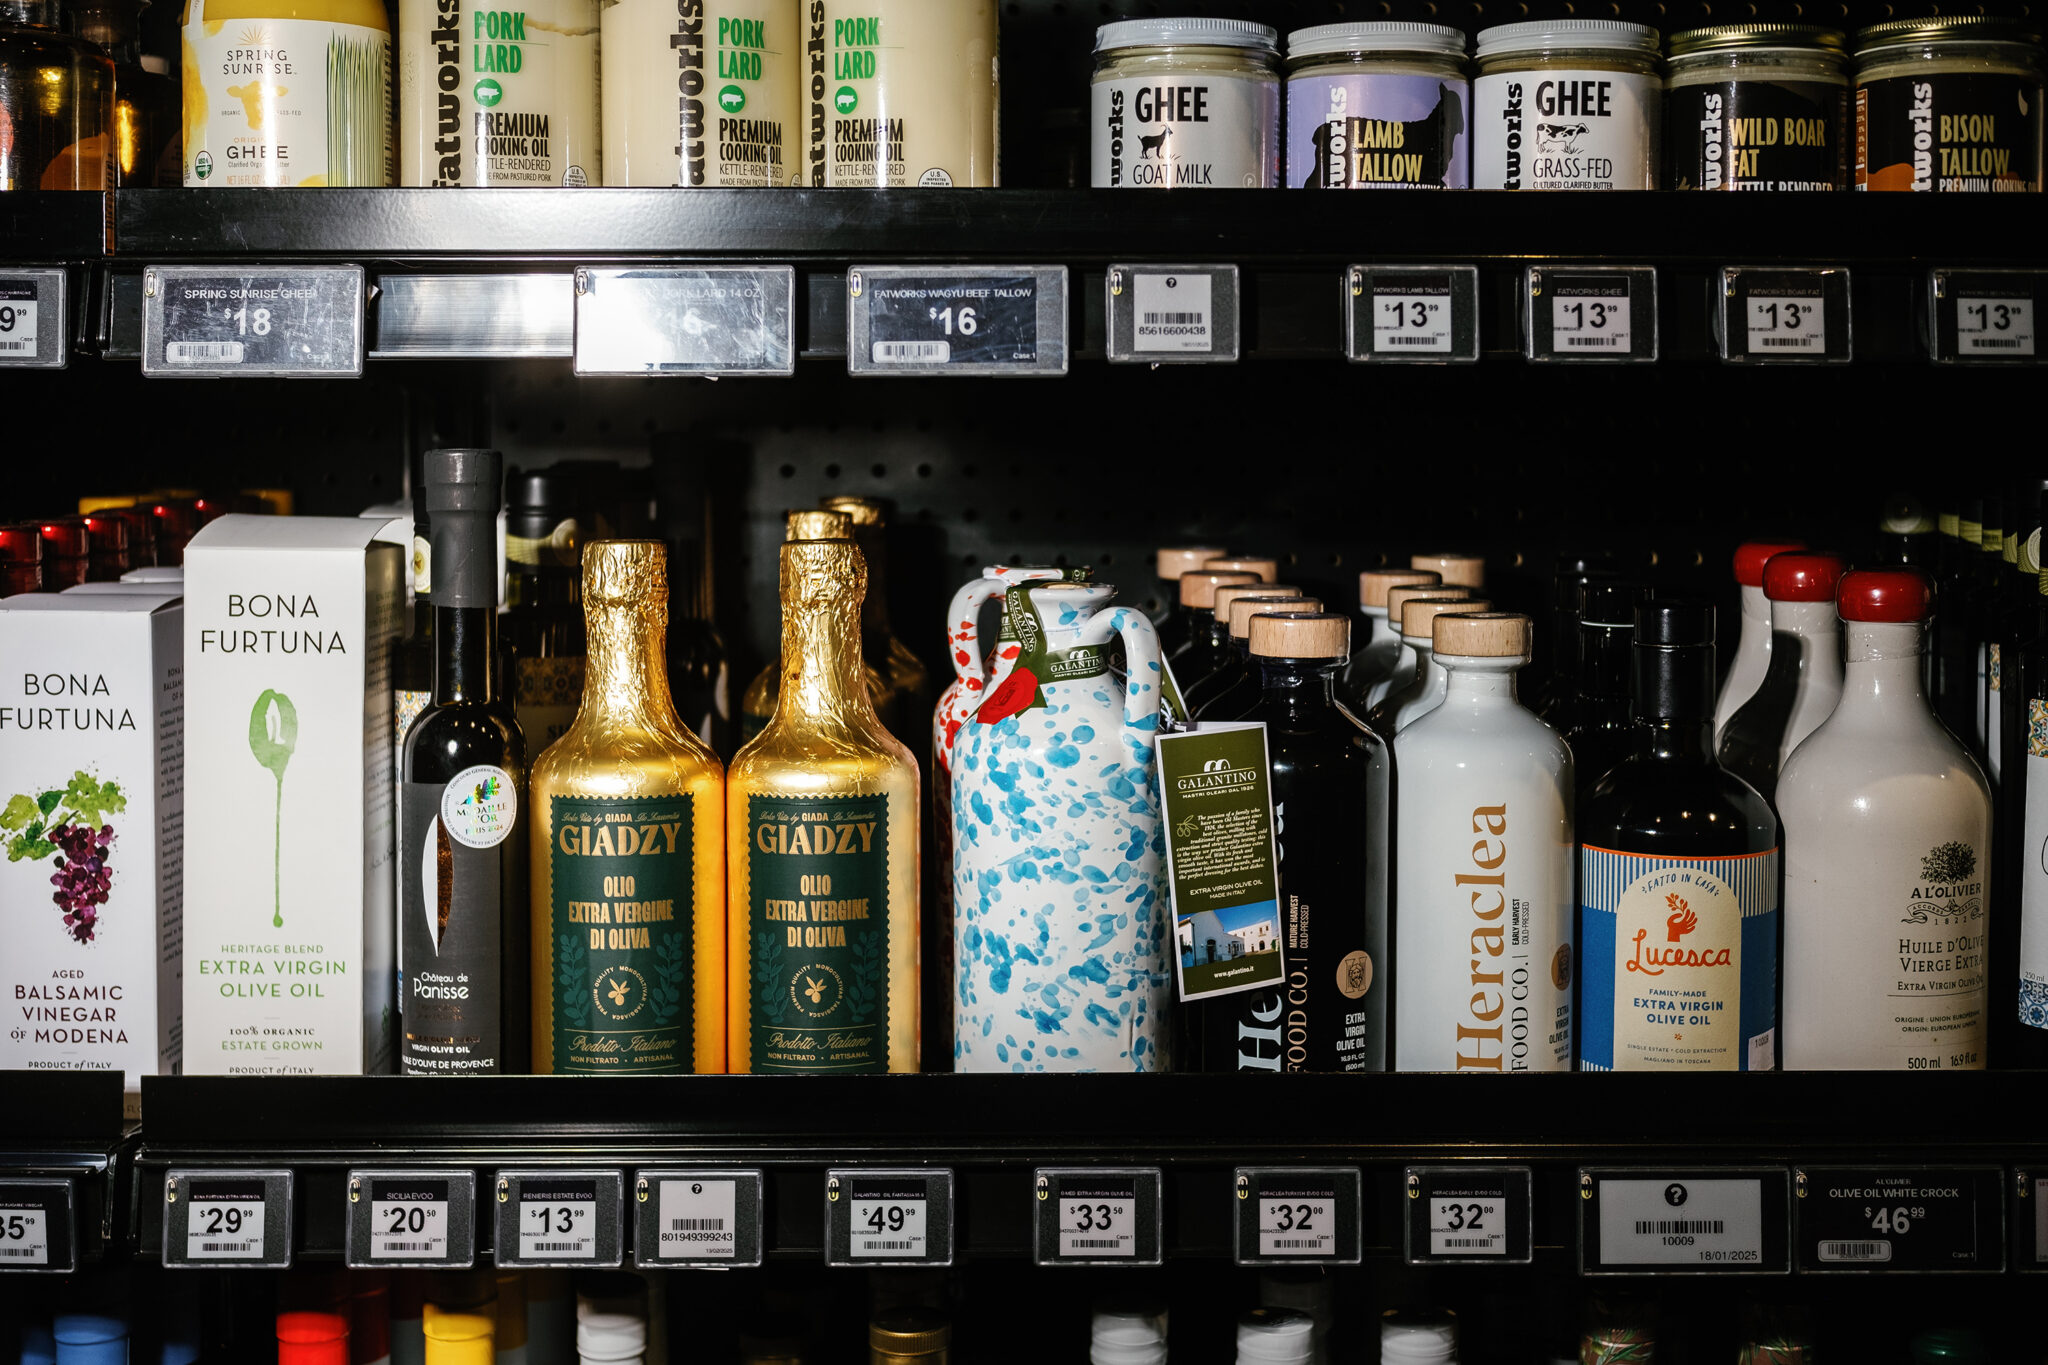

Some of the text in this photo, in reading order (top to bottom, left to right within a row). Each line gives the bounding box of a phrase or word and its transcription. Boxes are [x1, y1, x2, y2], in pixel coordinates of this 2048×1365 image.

[475, 11, 525, 40] PORK
[719, 17, 765, 49] PORK
[835, 18, 880, 47] PORK
[227, 50, 287, 62] SPRING
[475, 45, 522, 73] LARD
[719, 51, 761, 81] LARD
[835, 51, 876, 81] LARD
[1135, 86, 1209, 123] GHEE
[1536, 80, 1612, 118] GHEE
[475, 113, 549, 138] PREMIUM
[719, 119, 783, 146] PREMIUM
[835, 118, 904, 144] PREMIUM
[1355, 121, 1405, 149] LAMB
[1729, 117, 1826, 147] WILD BOAR
[1941, 115, 1996, 144] BISON
[531, 139, 549, 157] OIL
[719, 144, 783, 166] COOKING OIL
[835, 144, 905, 164] COOKING OIL
[719, 163, 784, 180] KETTLE-RENDERED
[1355, 153, 1424, 183] TALLOW
[1533, 157, 1613, 180] GRASS-FED
[1730, 149, 1760, 177] FAT
[1941, 148, 2012, 177] TALLOW
[1133, 164, 1213, 186] GOAT MILK
[1939, 178, 1990, 191] PREMIUM
[185, 289, 313, 299] SPRING SUNRISE GHEE
[729, 288, 741, 298] 14
[874, 289, 1032, 299] FATWORKS WAGYU BEEF TALLOW
[1557, 288, 1623, 296] FATWORKS GHEE
[228, 594, 320, 618] BONA
[201, 630, 347, 654] FURTUNA
[24, 673, 111, 697] BONA
[0, 708, 137, 731] FURTUNA
[1177, 770, 1257, 791] GALANTINO
[605, 813, 632, 823] GIADA
[559, 823, 683, 857] GIADZY
[757, 821, 878, 856] GIADZY
[604, 875, 636, 898] OLIO
[800, 874, 832, 896] OLIO
[1190, 879, 1263, 897] EXTRA VIRGIN OIL
[1648, 872, 1691, 892] FATTO IN
[1911, 882, 1982, 899] A L'OLIVIER
[568, 899, 675, 923] EXTRA VERGINE
[766, 897, 870, 921] EXTRA VERGINE
[1289, 895, 1299, 948] MATURE HARVEST
[1300, 904, 1309, 949] COLD-PRESSED
[1511, 898, 1520, 945] EARLY HARVEST
[590, 927, 651, 950] DI OLIVA
[787, 925, 847, 947] DI OLIVA
[1455, 803, 1506, 1070] Heraclea
[221, 944, 324, 954] HERITAGE BLEND
[1626, 928, 1732, 977] Lucesca
[52, 970, 85, 979] AGED
[200, 960, 347, 976] EXTRA VIRGIN
[421, 972, 469, 983] Château de
[1213, 966, 1255, 979] www.galantino.it
[2024, 971, 2045, 983] 250 ml
[15, 984, 123, 1001] BALSAMIC
[220, 983, 325, 998] OLIVE OIL
[413, 977, 469, 1000] Panisse
[1287, 964, 1308, 1005] CO.
[1649, 988, 1707, 998] FAMILY-MADE
[22, 1006, 116, 1022] VINEGAR
[1633, 998, 1723, 1011] EXTRA VIRGIN
[1345, 1011, 1365, 1025] EXTRA
[1511, 961, 1529, 1071] FOOD CO.
[1646, 1013, 1710, 1025] OLIVE OIL
[1895, 1015, 1951, 1024] ORIGINE UNION
[35, 1029, 129, 1044] MODENA
[230, 1026, 316, 1037] 100% ORGANIC
[1345, 1025, 1365, 1038] VIRGIN
[222, 1041, 323, 1051] ESTATE GROWN
[430, 1046, 471, 1054] OLIVE OIL
[1336, 1039, 1355, 1052] OLIVE
[29, 1061, 112, 1070] PRODUCT ITALY
[438, 1058, 495, 1069] DE PROVENCE
[570, 1054, 674, 1065] NON FILTRATO ARTISANAL
[1907, 1056, 1941, 1070] 500 ml
[229, 1066, 315, 1075] PRODUCT ITALY
[1829, 1188, 1959, 1198] OLIVE OIL WHITE CROCK
[1661, 1237, 1695, 1246] 10009
[1699, 1251, 1758, 1262] 18/01/2025
